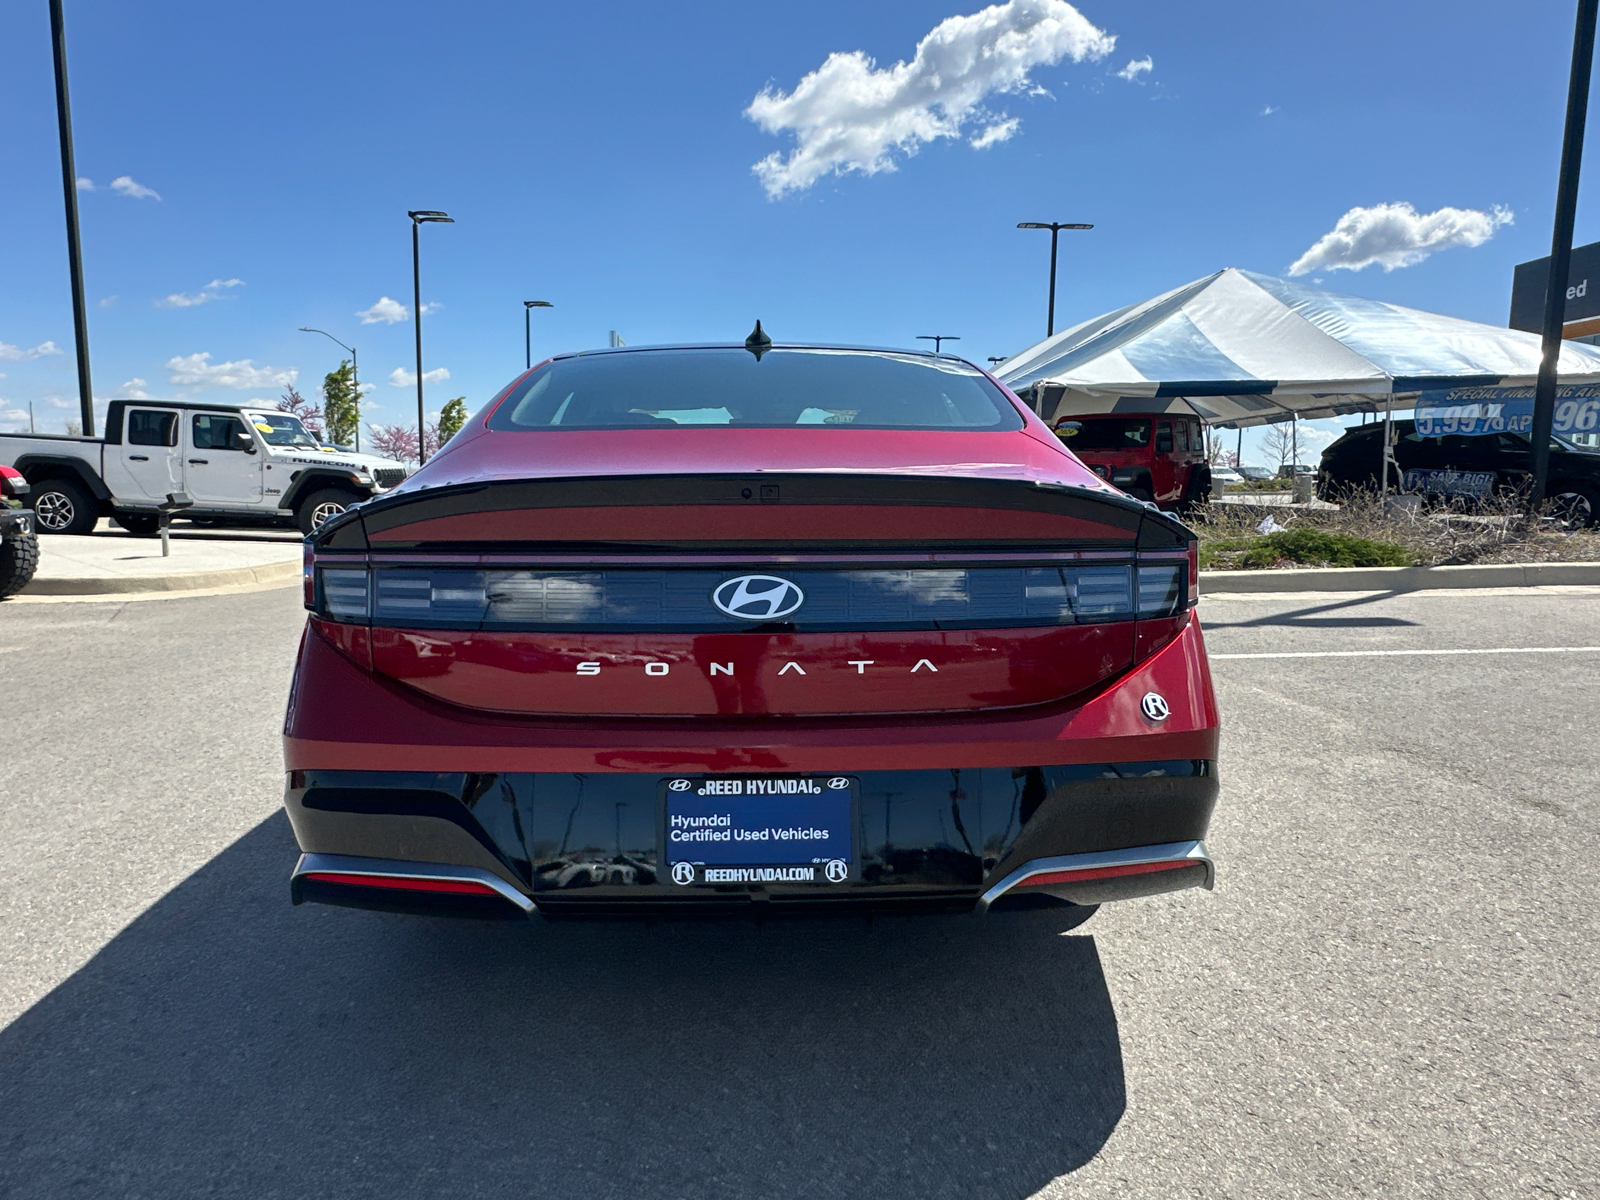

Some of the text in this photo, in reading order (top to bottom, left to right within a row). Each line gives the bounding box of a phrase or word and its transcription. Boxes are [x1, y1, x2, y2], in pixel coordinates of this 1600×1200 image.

[1446, 389, 1498, 400] SPECIAL
[1501, 386, 1571, 399] FINANNG
[1418, 403, 1505, 435] 5.99%
[1506, 415, 1533, 431] AP
[292, 457, 356, 468] RUBICON
[1429, 471, 1491, 485] SAVE BIG!
[576, 658, 938, 676] SONATA
[705, 779, 813, 795] REED HYUNDAI
[671, 814, 731, 829] Hyundai
[671, 827, 829, 842] Certified Used Vehicles
[705, 867, 814, 882] REEDHYUNDAI.COM
